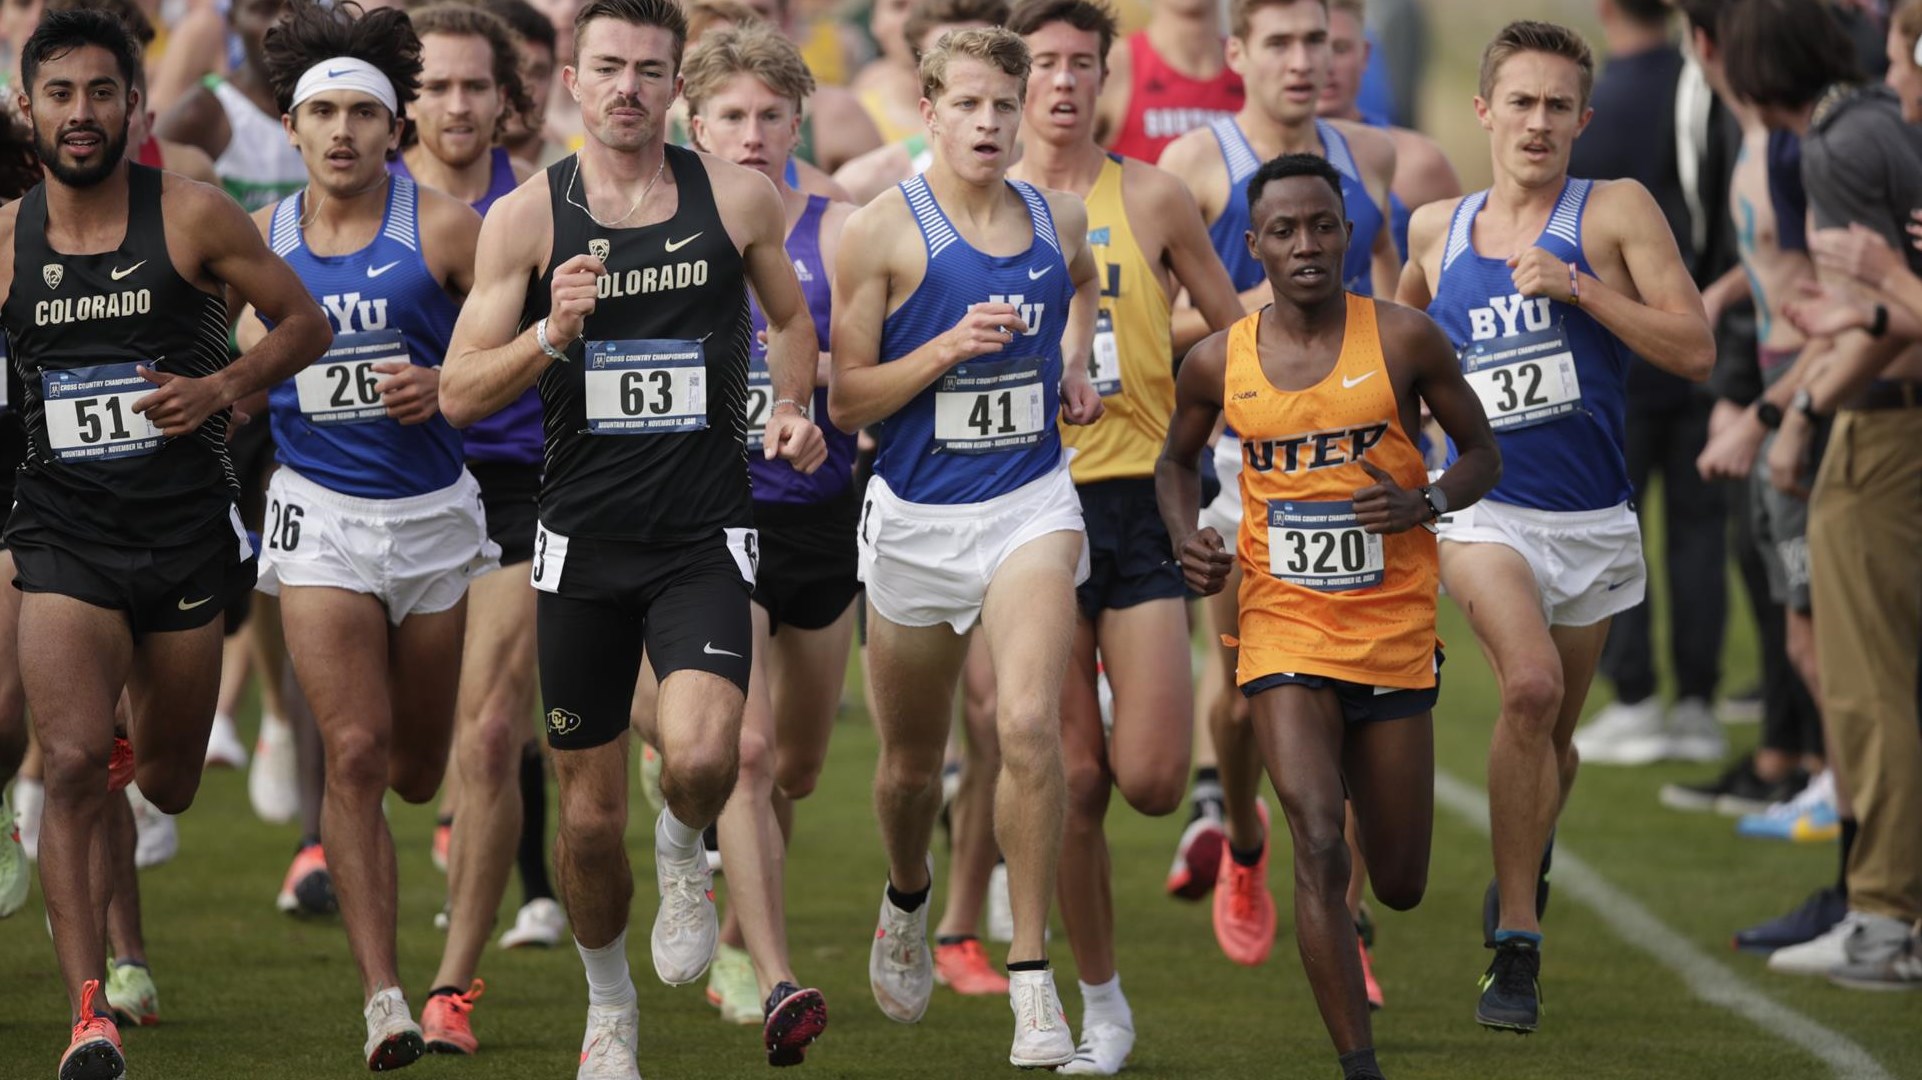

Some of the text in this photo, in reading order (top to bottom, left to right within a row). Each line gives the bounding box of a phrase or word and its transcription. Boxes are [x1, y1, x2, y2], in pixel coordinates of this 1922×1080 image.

[597, 259, 708, 299] OLORADO
[35, 288, 151, 326] COLORADO
[320, 292, 388, 335] YU
[1468, 293, 1551, 341] BYU
[605, 351, 699, 363] CROSS COUNTRY CHAMPIONSHIPS
[60, 376, 149, 392] CROSS COUNTRY CHAMPIONSHIP
[326, 362, 381, 408] 26
[620, 370, 673, 416] 63
[1492, 363, 1548, 412] 32
[75, 396, 131, 444] 51
[647, 419, 676, 428] NOVEMBER
[968, 391, 1016, 436] 41
[61, 449, 86, 459] MOUNTAIN
[86, 446, 105, 457] REGION
[108, 443, 135, 454] NOVEMBER
[144, 439, 158, 449] 2021
[1242, 419, 1390, 474] UTEP
[270, 499, 304, 551] 26
[1302, 514, 1328, 523] COUNTRY
[1285, 530, 1365, 573] 320
